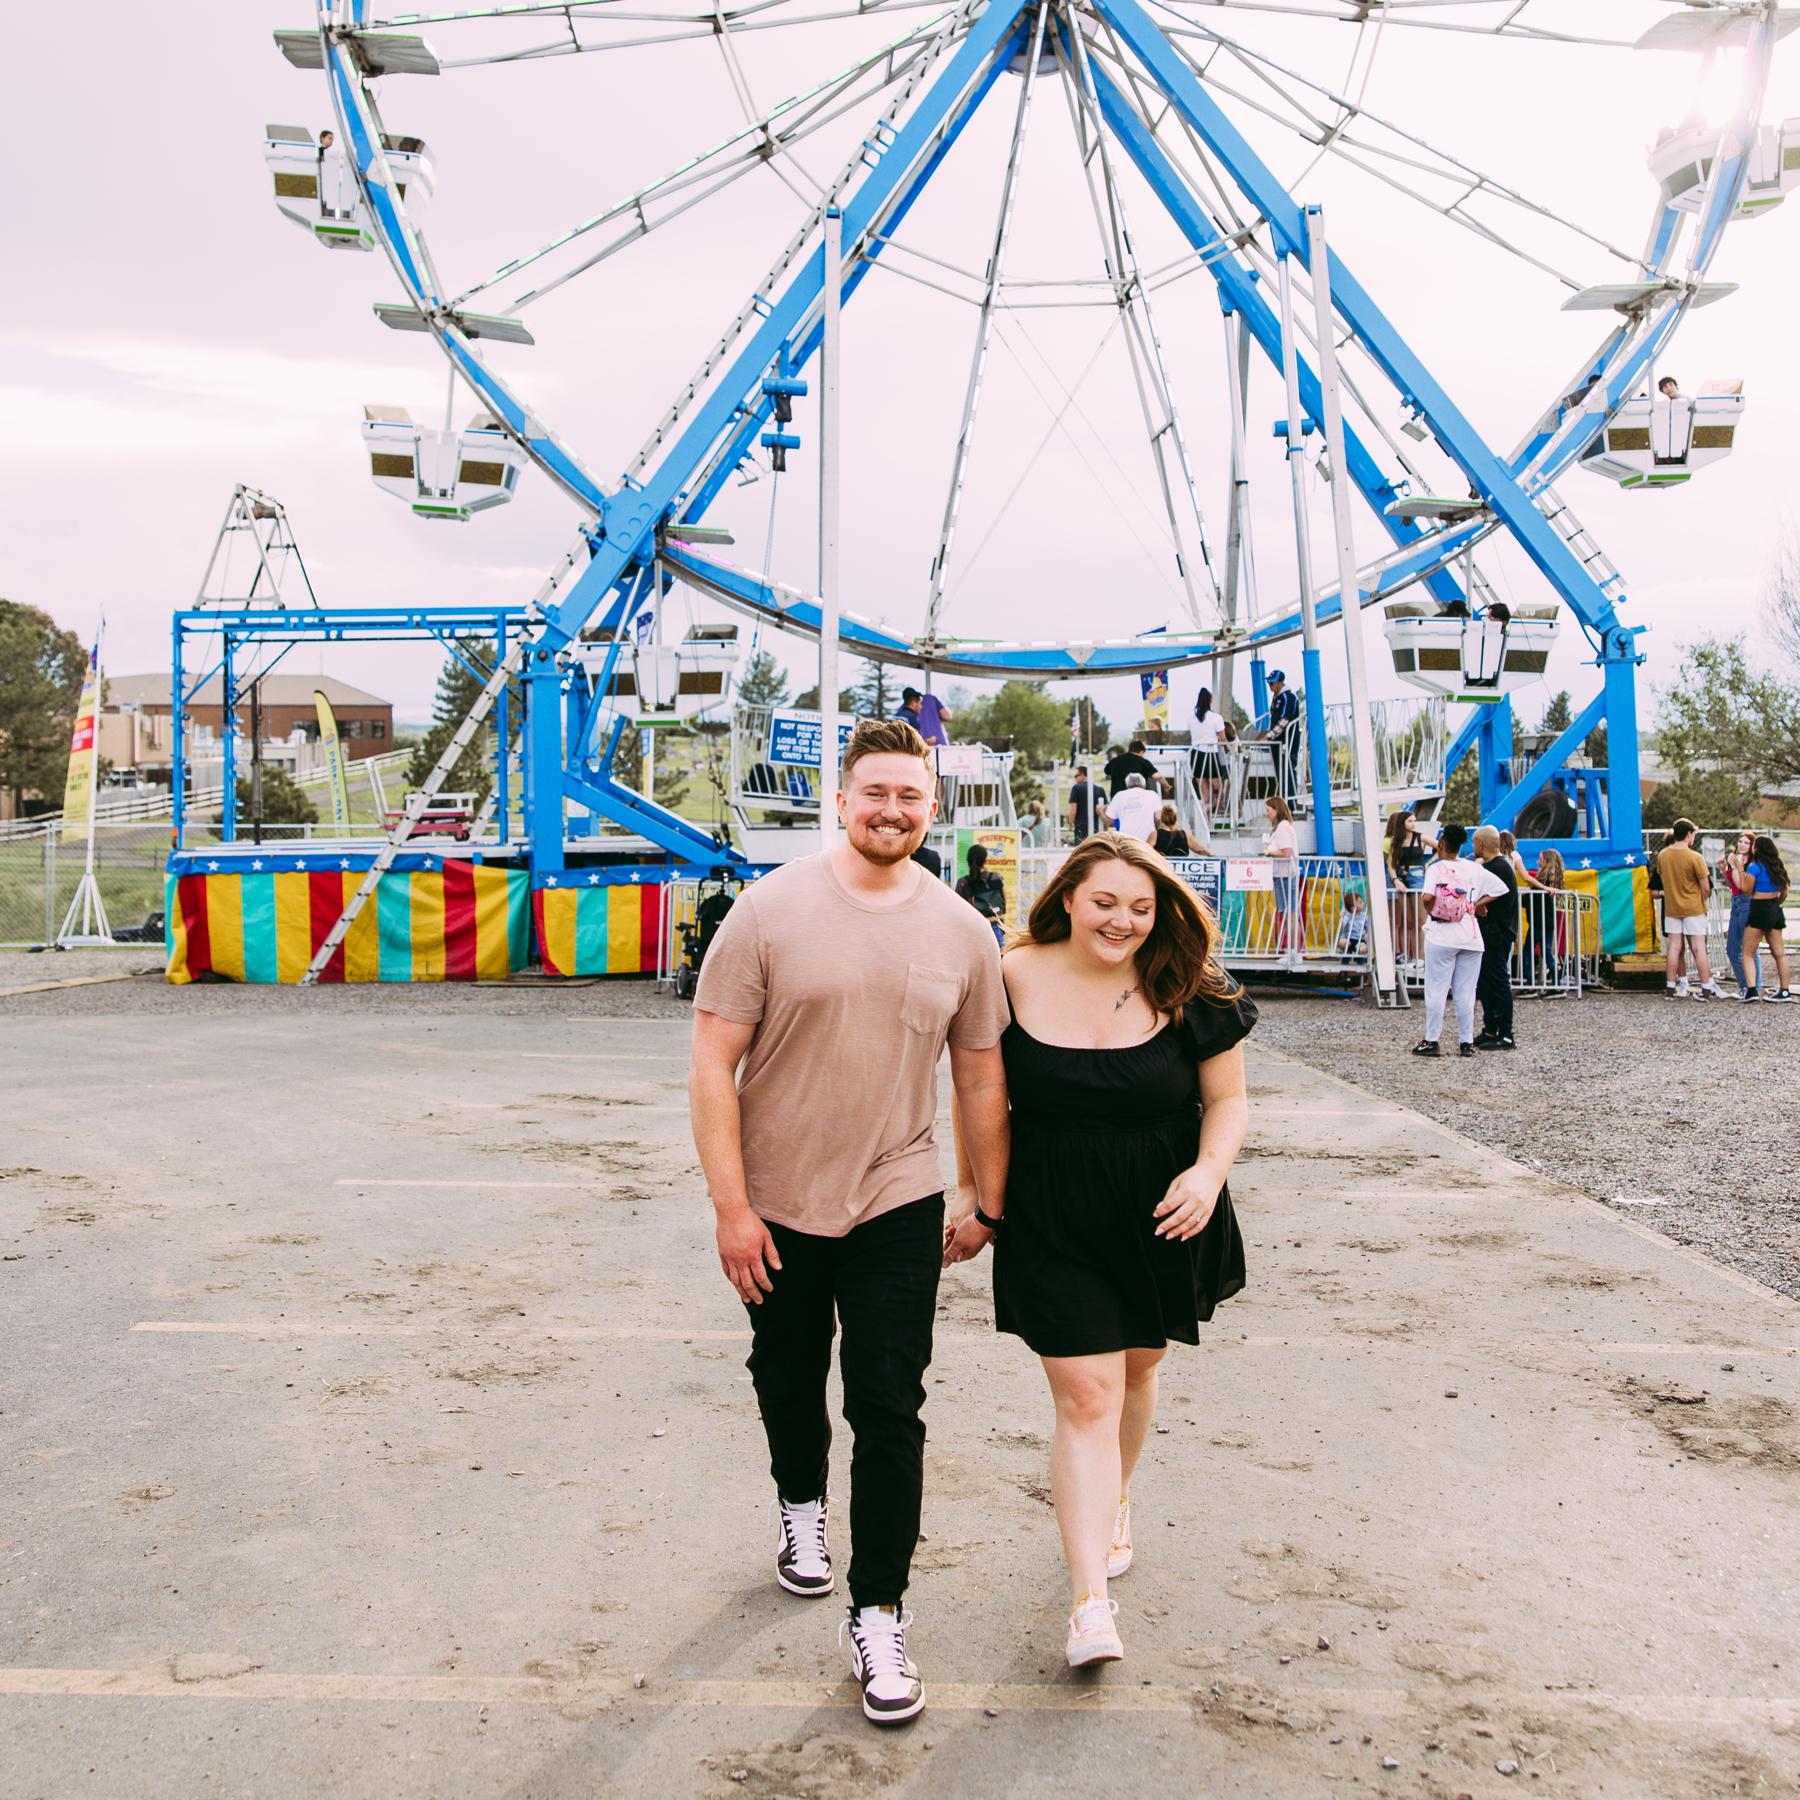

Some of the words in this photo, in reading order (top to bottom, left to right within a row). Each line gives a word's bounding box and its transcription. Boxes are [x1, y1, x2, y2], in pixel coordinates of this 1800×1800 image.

[780, 722, 796, 730] NOT
[797, 731, 812, 739] FOR
[777, 736, 797, 745] LOSS
[798, 738, 810, 746] OR
[1171, 862, 1215, 873] TICE
[1246, 867, 1253, 877] 6
